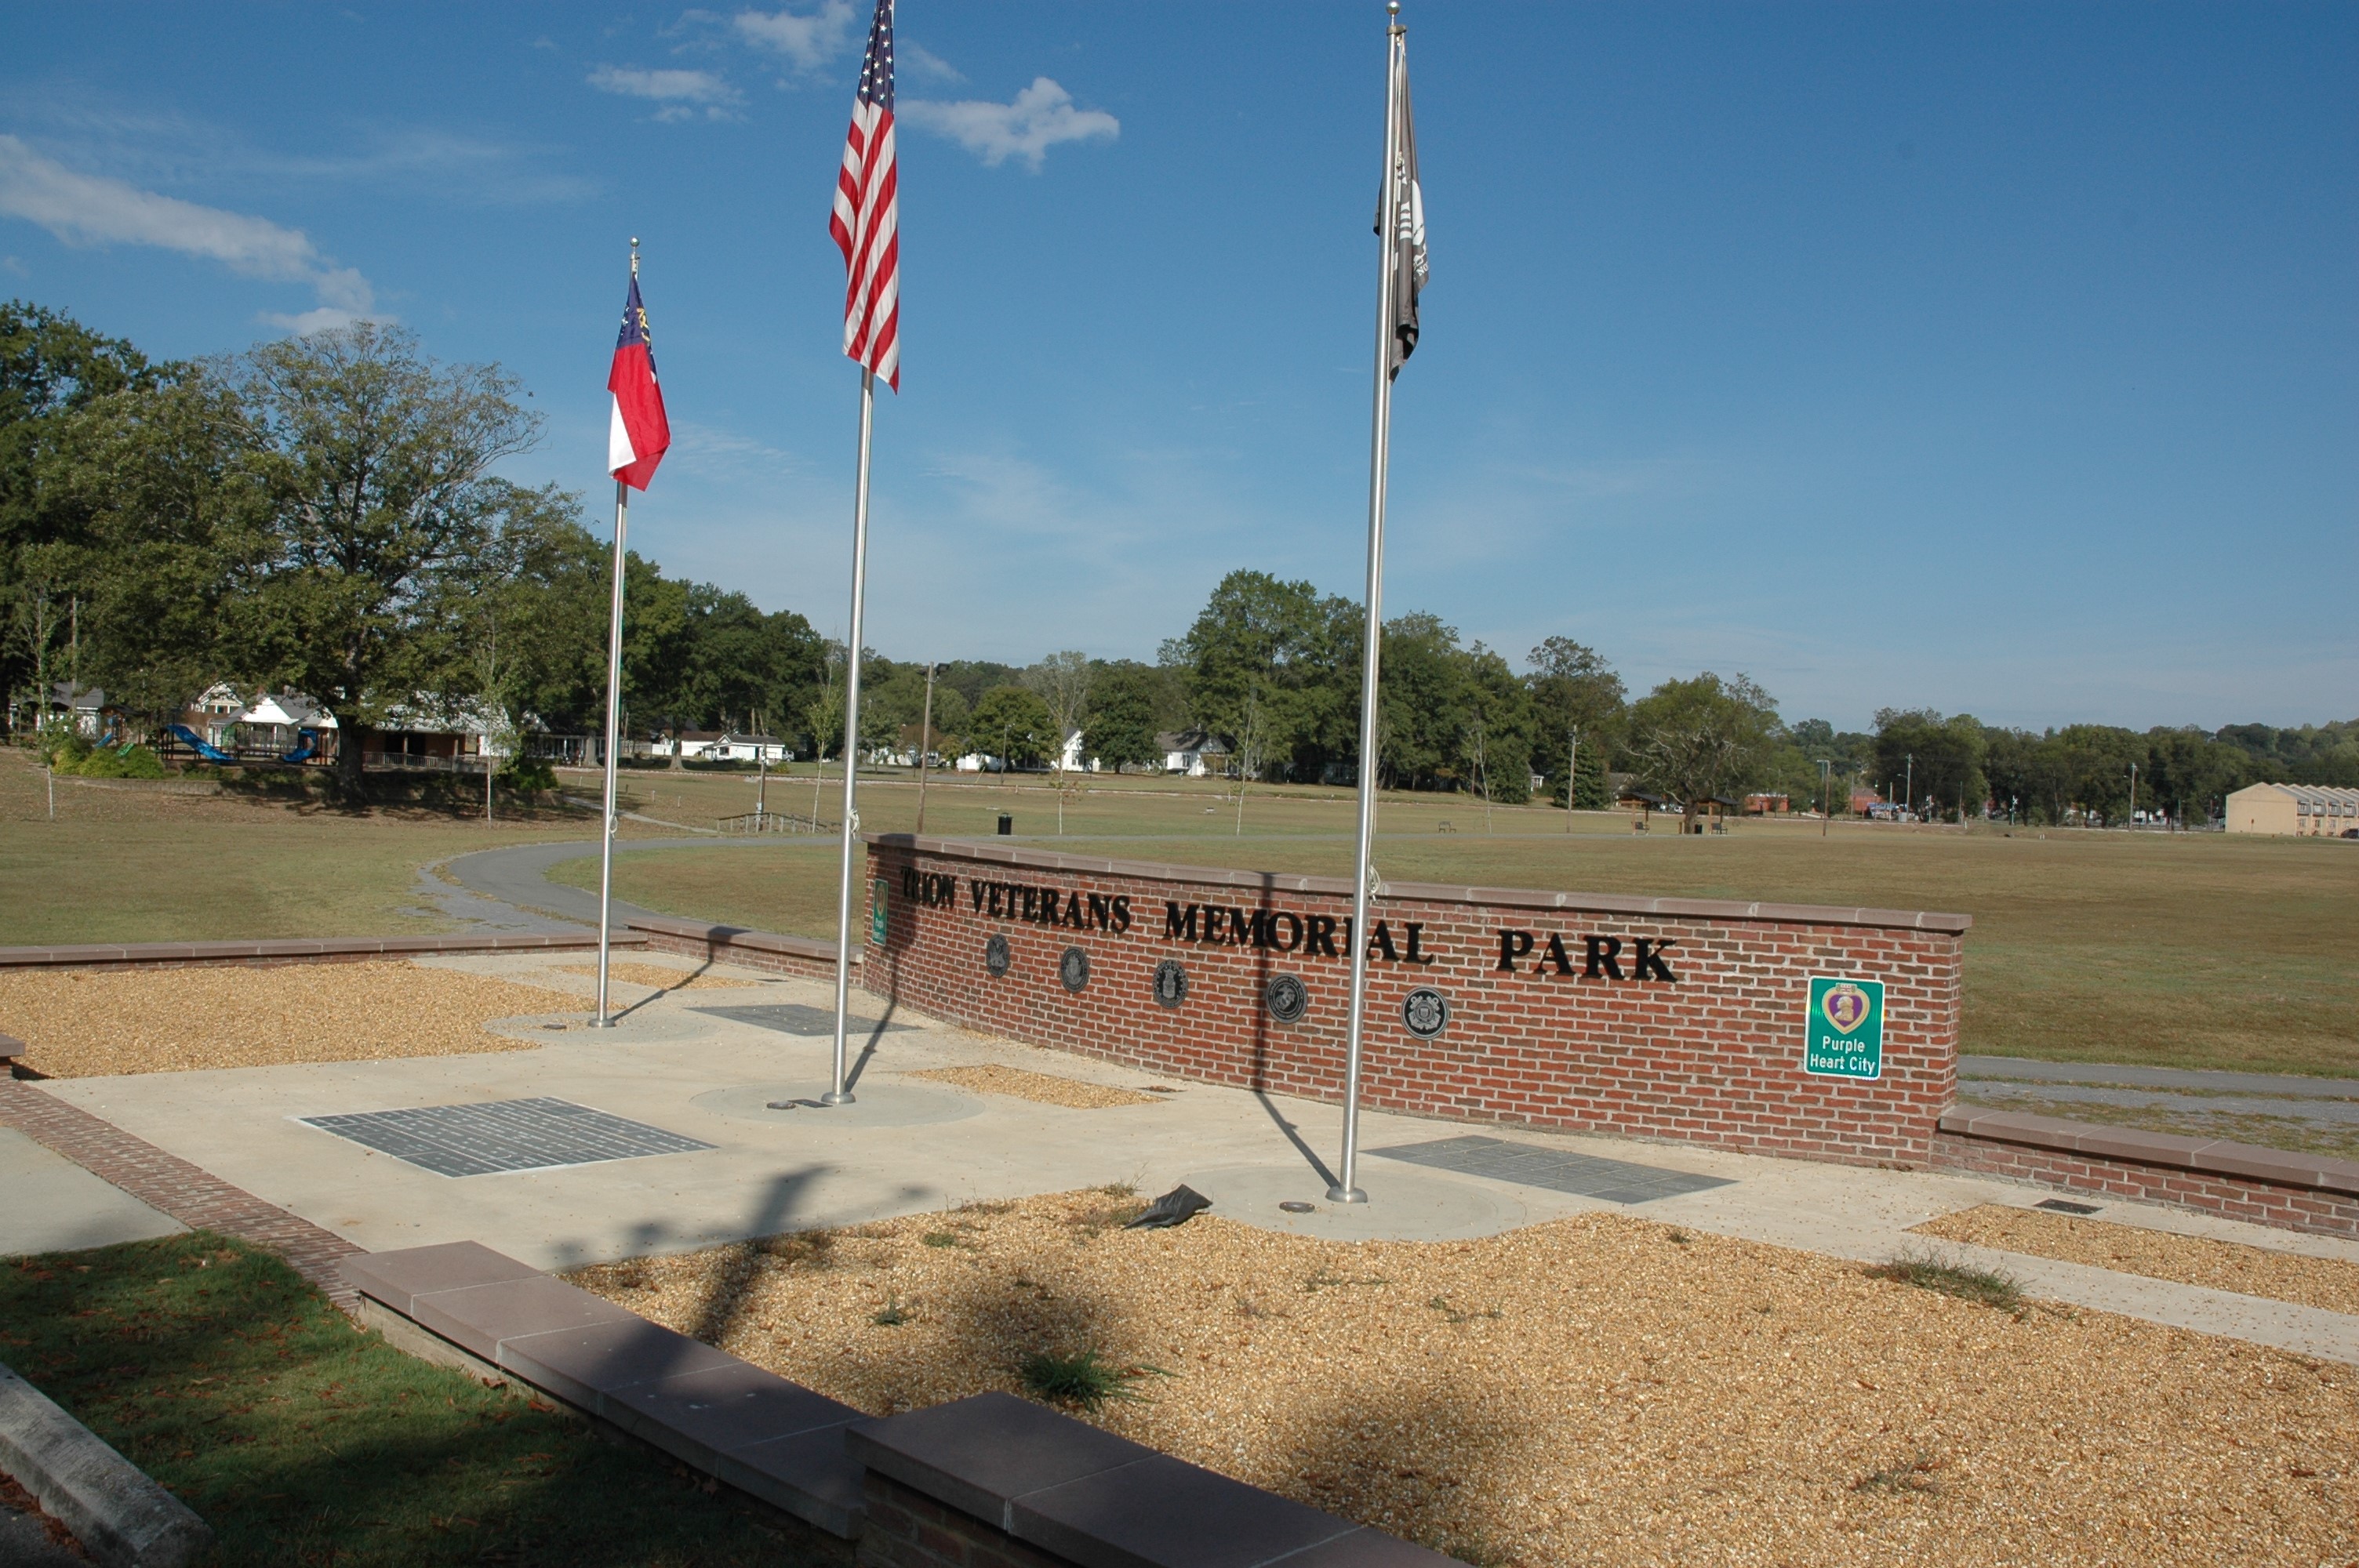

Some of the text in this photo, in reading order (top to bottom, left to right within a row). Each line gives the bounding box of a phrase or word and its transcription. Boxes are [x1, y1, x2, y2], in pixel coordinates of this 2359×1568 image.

[900, 866, 1678, 982] TRION VETERANS MEMORIAL PARK
[1822, 1035, 1866, 1054] Purple
[1810, 1053, 1877, 1076] Heart City
